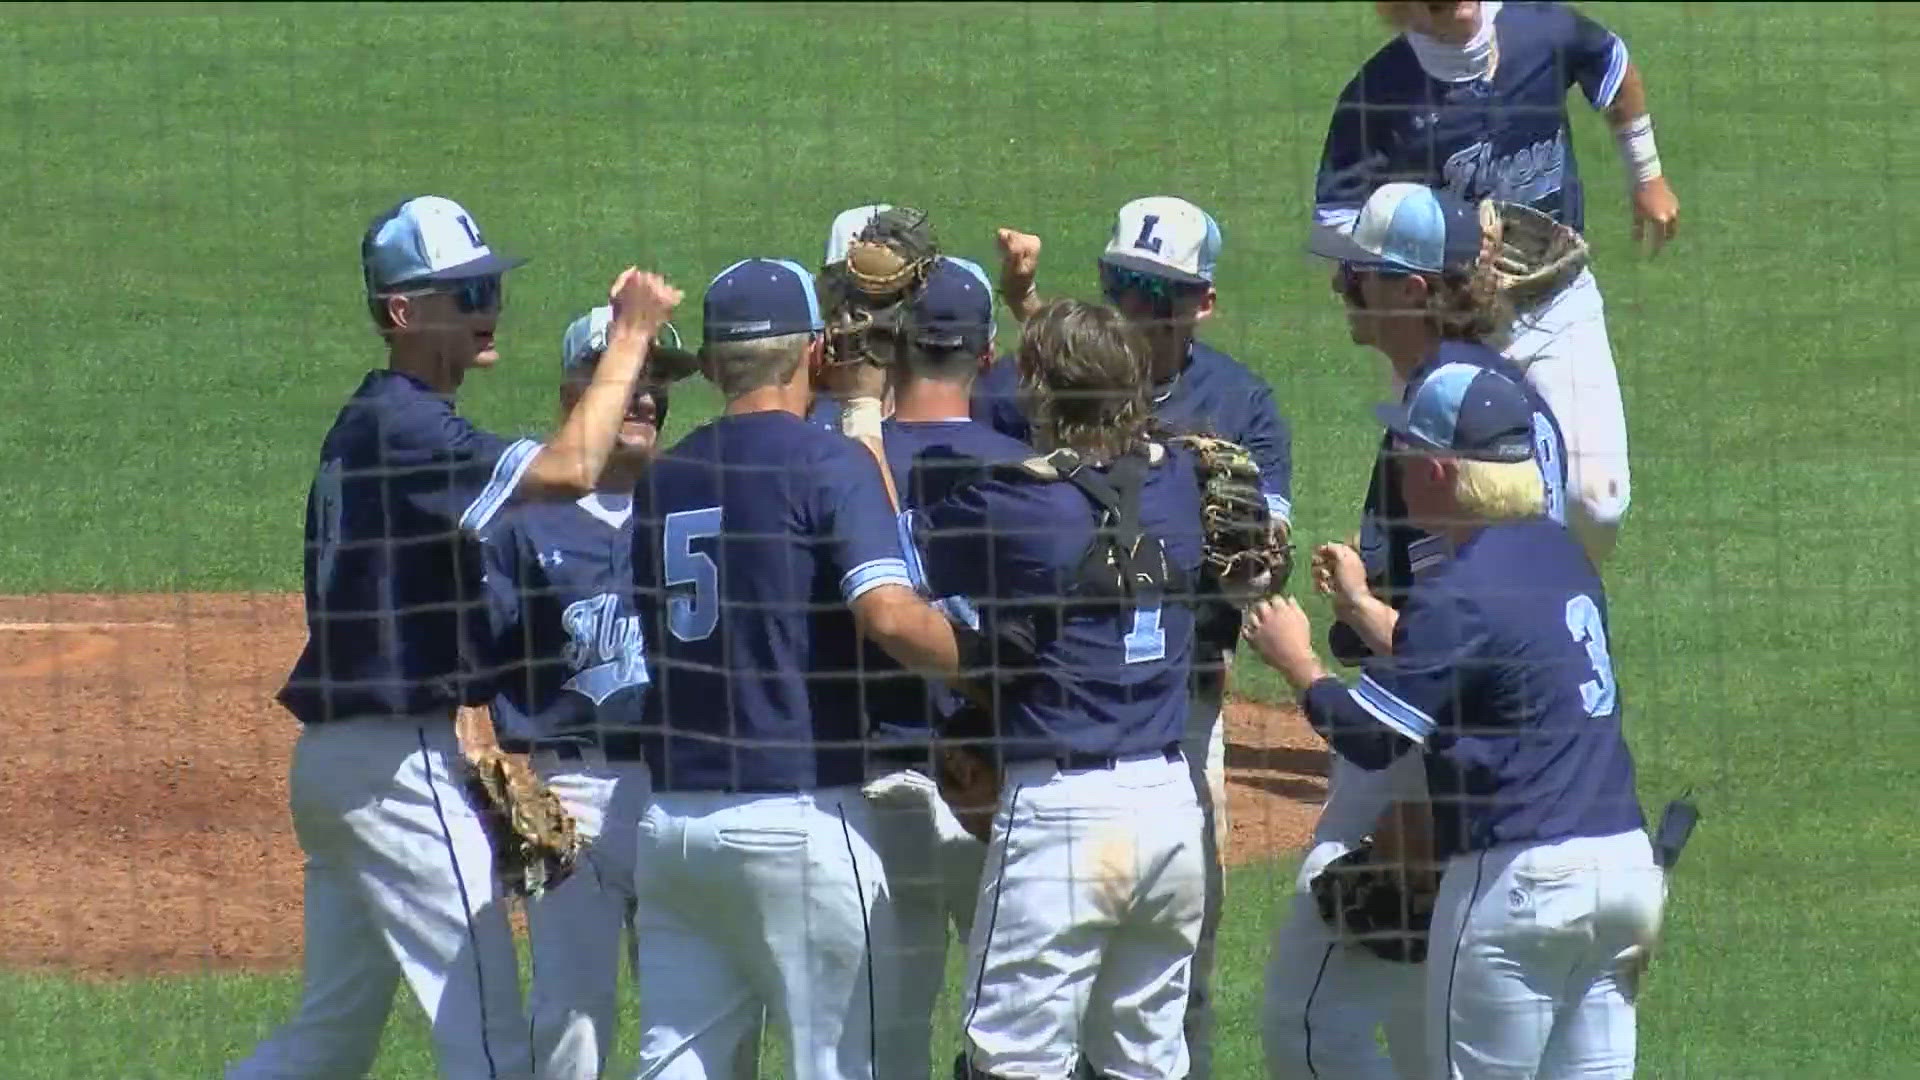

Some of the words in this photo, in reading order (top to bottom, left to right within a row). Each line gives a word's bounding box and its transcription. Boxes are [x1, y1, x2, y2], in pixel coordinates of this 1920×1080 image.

[456, 215, 485, 248] L
[1134, 215, 1162, 254] L
[664, 506, 723, 642] 5
[1565, 595, 1616, 718] 3
